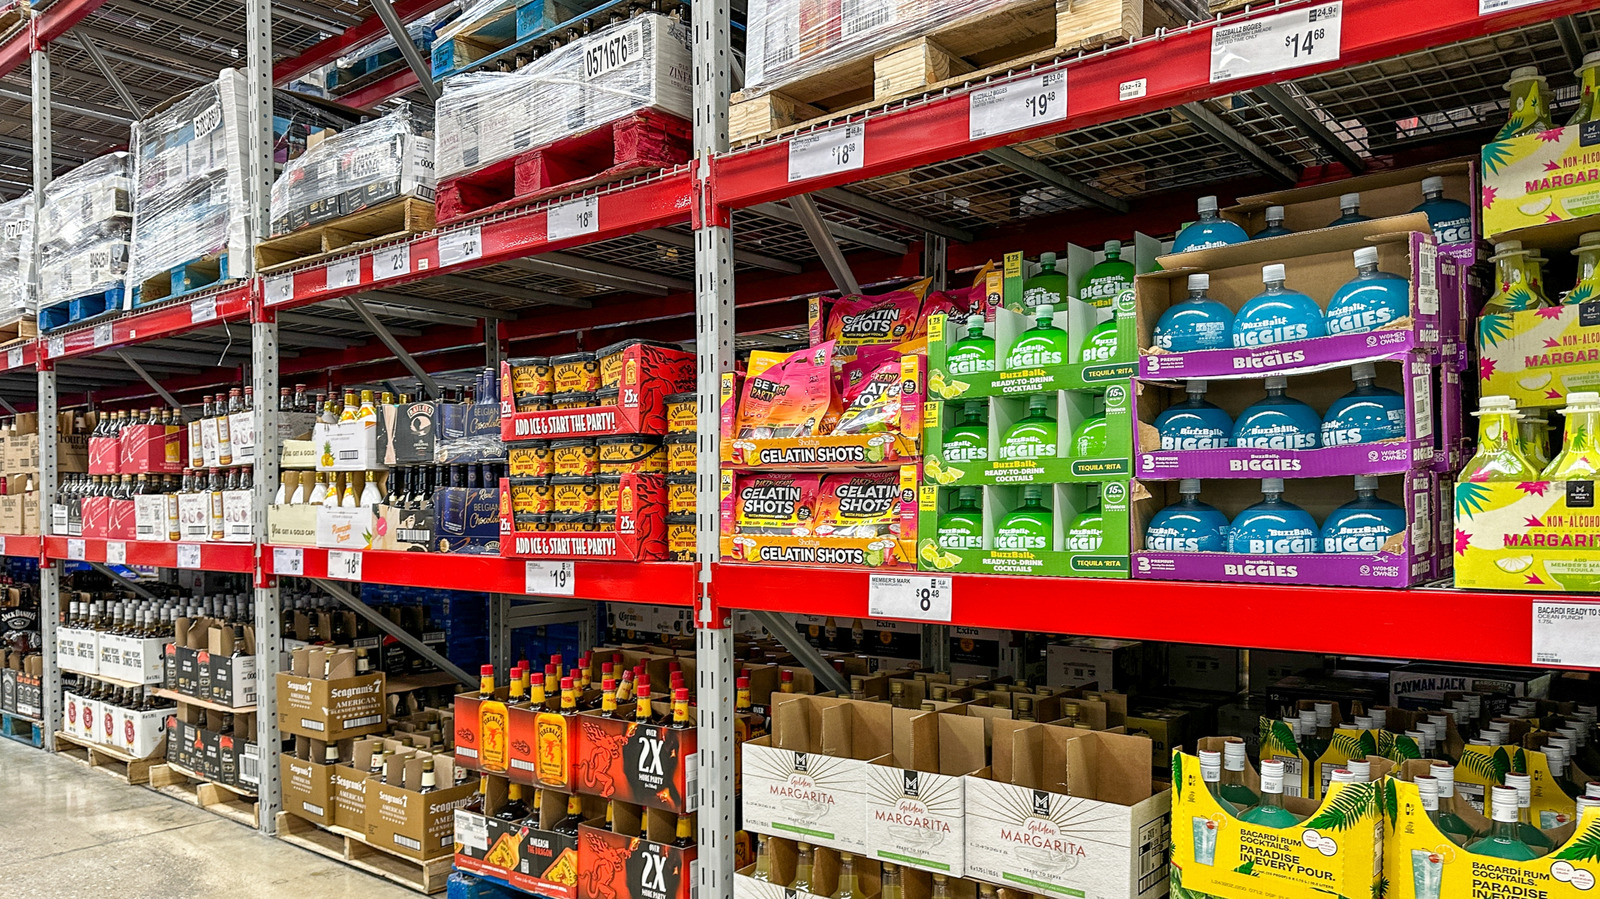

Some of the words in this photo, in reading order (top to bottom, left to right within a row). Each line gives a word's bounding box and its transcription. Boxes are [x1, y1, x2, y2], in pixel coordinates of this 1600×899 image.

[1216, 26, 1242, 38] BUZZBALLZ
[1242, 22, 1262, 33] BIGGIES
[586, 34, 628, 77] 0571676
[843, 308, 900, 324] GELATIN
[842, 320, 891, 332] SHOTS
[1233, 323, 1308, 348] BIGGIES
[1379, 331, 1405, 340] WOMEN
[1380, 337, 1405, 345] OWNED
[1147, 355, 1159, 371] 3
[1233, 350, 1305, 369] BIGGIES
[1089, 368, 1115, 377] TEQUILA
[903, 381, 914, 389] 25
[991, 375, 1054, 388] READY-TO-DRINK
[1003, 383, 1042, 393] COCKTAILS
[624, 389, 638, 404] 25x
[474, 407, 499, 417] BELGIAN
[501, 401, 511, 413] 25x
[515, 419, 530, 436] ADD
[530, 417, 542, 435] ICE
[541, 417, 548, 433] &
[549, 415, 570, 434] START
[570, 414, 586, 432] THE
[587, 411, 616, 430] PARTY!
[761, 448, 816, 463] GELATIN
[817, 446, 864, 462] SHOTS
[1078, 463, 1103, 471] TEQUILA
[1142, 455, 1155, 470] 3
[1230, 459, 1302, 471] BIGGIES
[985, 467, 1045, 476] READY-TO-DRINK
[996, 474, 1034, 482] COCKTAILS
[742, 486, 801, 501] GELATIN
[836, 484, 900, 498] GELATIN
[903, 490, 913, 498] 25
[744, 500, 794, 514] SHOTS
[800, 508, 809, 516] 25
[840, 498, 892, 512] SHOTS
[500, 518, 511, 531] 25x
[620, 516, 634, 530] 25x
[515, 538, 530, 555] ADD
[530, 538, 542, 554] ICE
[542, 538, 549, 555] &
[549, 538, 571, 555] START
[571, 538, 587, 554] THE
[587, 538, 616, 556] PARTY!
[761, 547, 815, 562] GELATIN
[816, 548, 863, 563] SHOTS
[983, 558, 1043, 566] READY-TO-DRINK
[1137, 556, 1151, 571] 3
[1224, 564, 1298, 577] BIGGIES
[1, 610, 15, 622] JACK
[15, 609, 37, 621] DANIEL'S
[1538, 606, 1565, 614] BACARDI
[1566, 607, 1587, 616] READY
[876, 620, 896, 629] Extra
[956, 627, 979, 636] Extra
[287, 681, 308, 692] Seagram's
[331, 684, 373, 698] Seagram's
[373, 679, 382, 693] 7
[1394, 678, 1435, 695] CAYMAN
[1437, 677, 1465, 690] JACK
[330, 706, 356, 715] BLENDED
[357, 703, 381, 711] WHISKEY
[335, 696, 376, 709] AMERICAN
[646, 729, 657, 737] OVER
[639, 737, 664, 776] 2X
[290, 763, 309, 776] Seagram's
[336, 775, 362, 790] Seagram's
[639, 774, 650, 782] MORE
[650, 775, 663, 785] PARTY
[791, 776, 812, 788] Golden
[339, 790, 364, 802] AMERICAN
[379, 790, 402, 805] Seagram's
[770, 785, 835, 805] MARGARITA
[381, 804, 405, 816] AMERICAN
[899, 801, 924, 815] Golden
[875, 810, 951, 833] MARGARITA
[1028, 820, 1057, 836] Golden
[1000, 828, 1087, 858] MARGARITA
[1240, 829, 1280, 844] BACARDÍ
[1281, 838, 1302, 848] RUM
[1240, 836, 1292, 852] COCKTAILS.
[649, 844, 660, 852] OVER
[1240, 845, 1300, 865] PARADISE
[642, 852, 667, 892] 2X
[1240, 853, 1251, 863] IN
[1255, 859, 1295, 873] EVERY
[1297, 867, 1336, 882] POUR.
[1472, 862, 1521, 876] BACARDÍ
[1524, 872, 1550, 880] RUM
[1047, 872, 1062, 880] SERVE
[1472, 870, 1537, 886] COCKTAILS.
[1472, 879, 1548, 899] PARADISE
